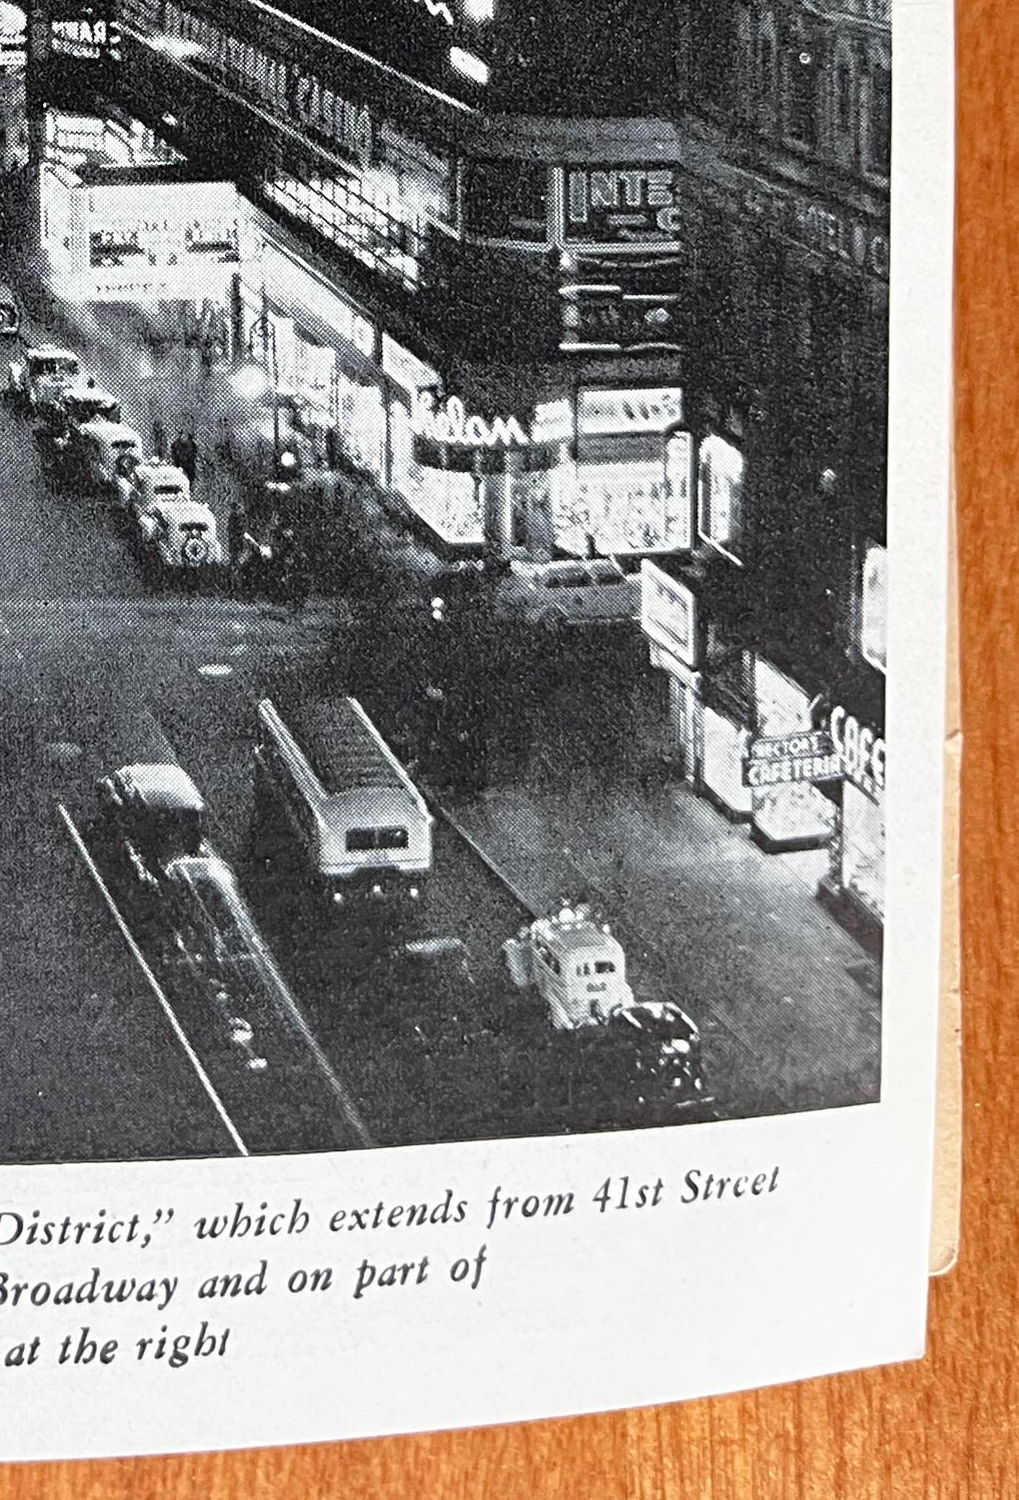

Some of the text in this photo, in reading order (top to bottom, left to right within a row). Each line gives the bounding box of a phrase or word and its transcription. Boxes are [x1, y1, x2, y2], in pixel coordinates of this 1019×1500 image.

[195, 1199, 309, 1239] which
[330, 1190, 467, 1231] extends
[487, 1187, 574, 1229] from
[593, 1176, 663, 1212] 41st
[681, 1167, 778, 1203] Street
[198, 1260, 267, 1298] and
[288, 1268, 332, 1293] on
[353, 1257, 428, 1299] part
[451, 1245, 486, 1289] of
[5, 1337, 40, 1367] at
[59, 1327, 118, 1364] the
[137, 1322, 229, 1368] right
